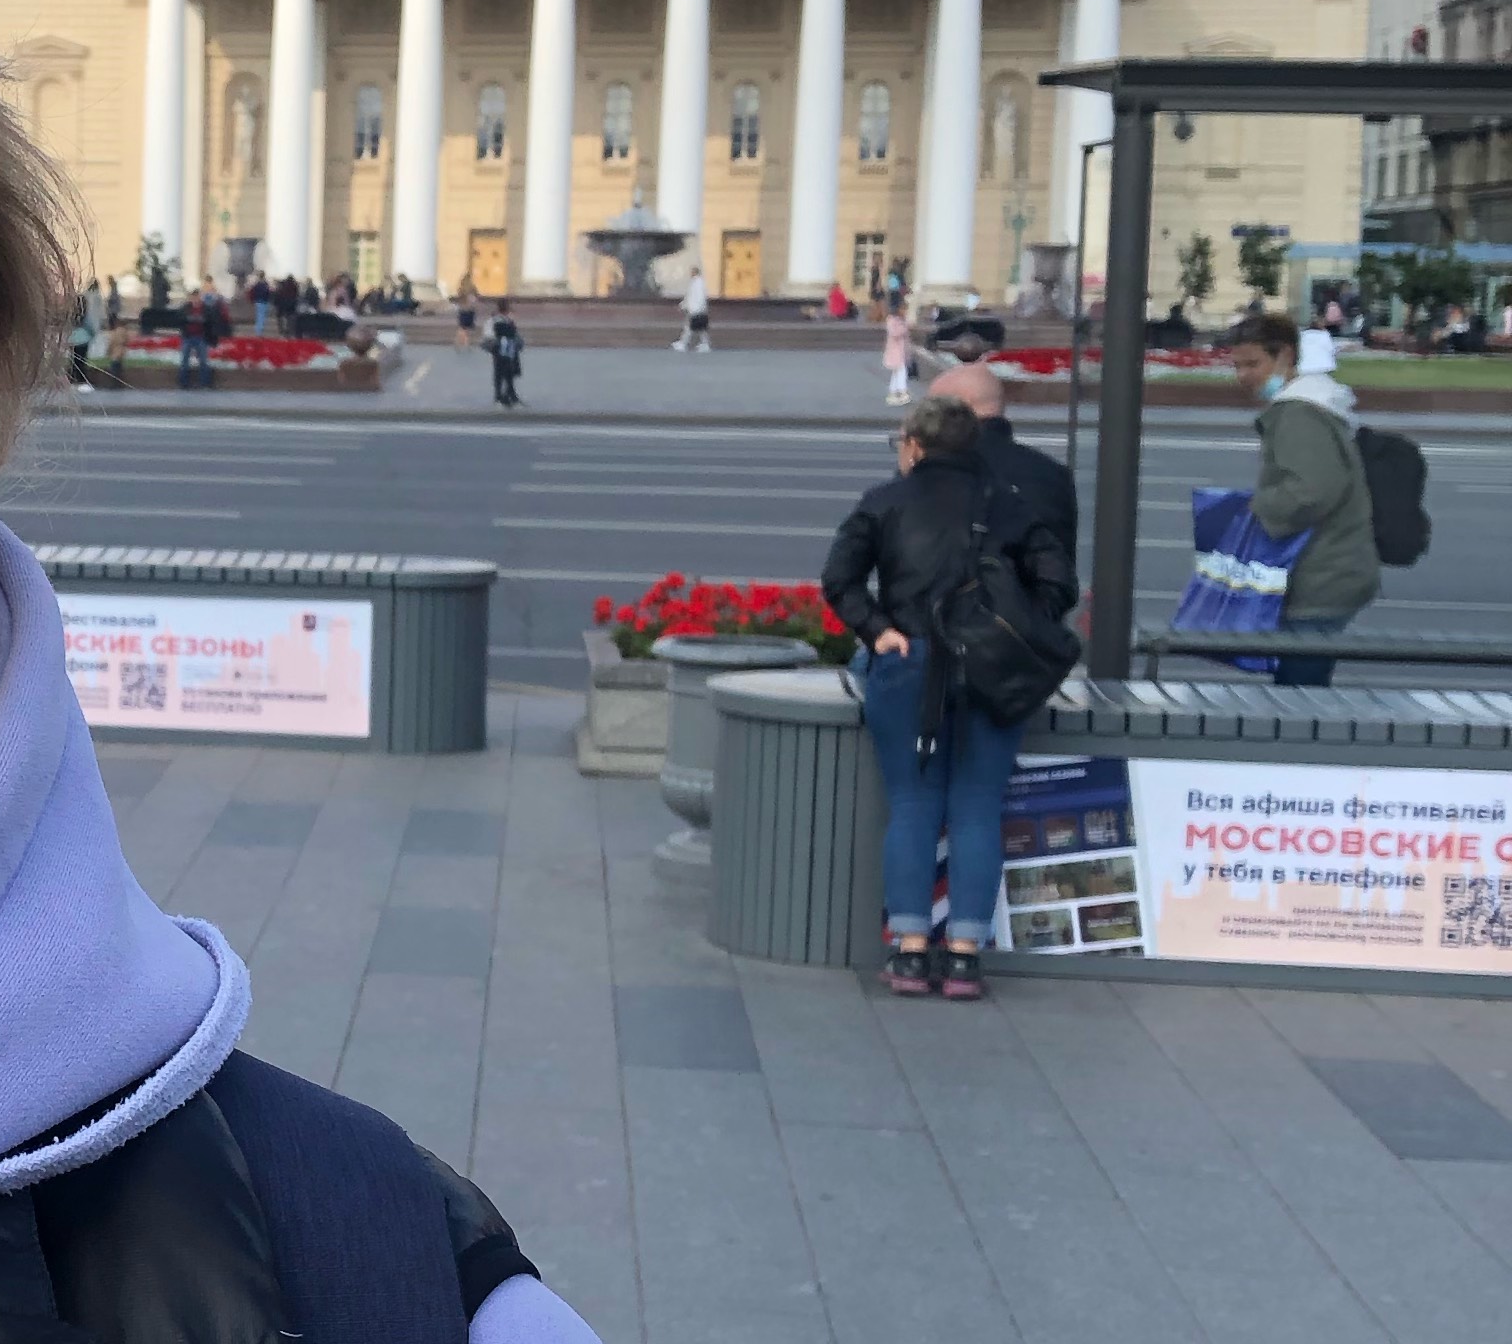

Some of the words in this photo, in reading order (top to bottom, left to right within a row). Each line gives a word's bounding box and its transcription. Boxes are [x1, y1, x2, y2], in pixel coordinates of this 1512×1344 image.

[151, 636, 264, 658] СЕЗОНЫ
[1188, 789, 1234, 810] Вся
[1242, 790, 1334, 817] афиша
[1344, 794, 1506, 822] фестивалей
[1185, 823, 1480, 861] МОСКОВСКИЕ
[1184, 864, 1196, 885] у
[1204, 858, 1263, 881] тебя
[1272, 867, 1285, 884] в
[1295, 867, 1425, 892] телефоне
